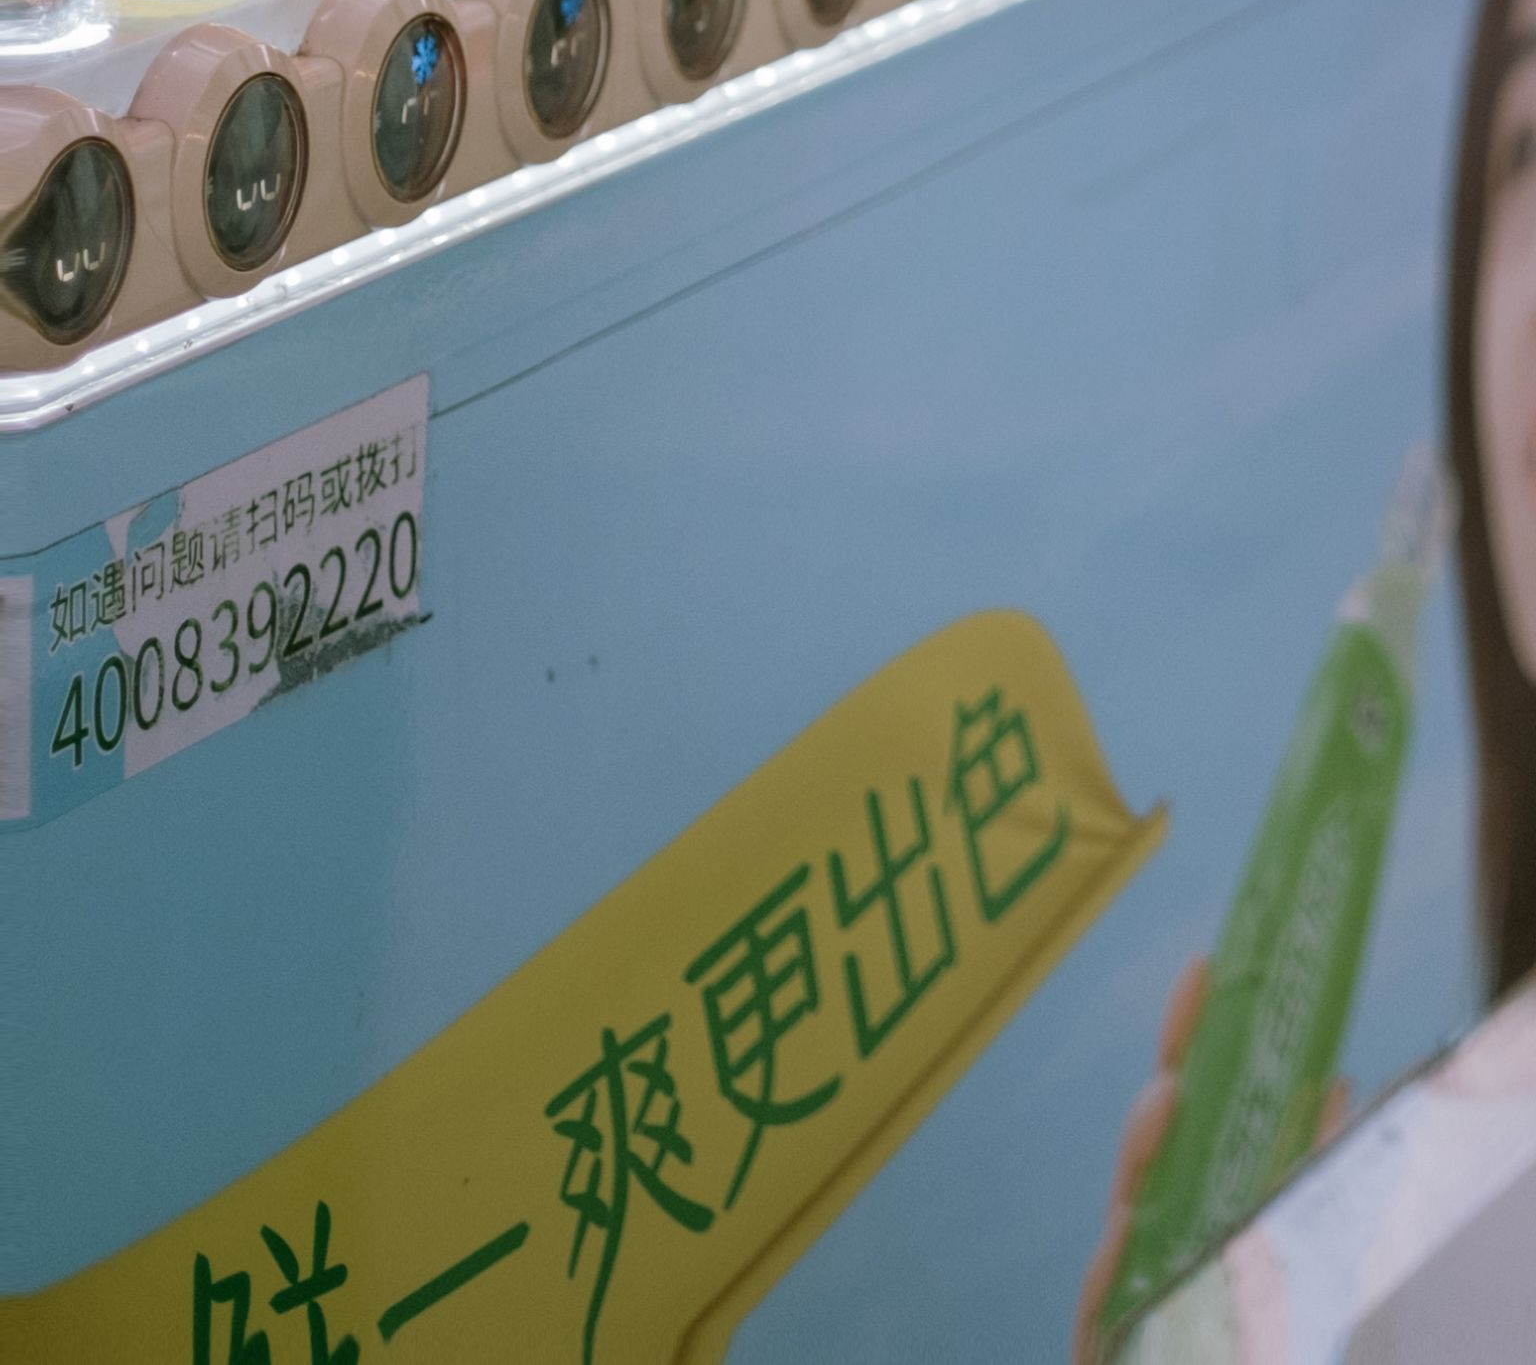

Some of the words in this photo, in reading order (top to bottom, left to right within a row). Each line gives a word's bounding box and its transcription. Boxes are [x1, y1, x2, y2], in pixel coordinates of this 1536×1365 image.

[49, 424, 418, 653] 如遇问题请扫码或拨打
[51, 510, 418, 769] 4008392220
